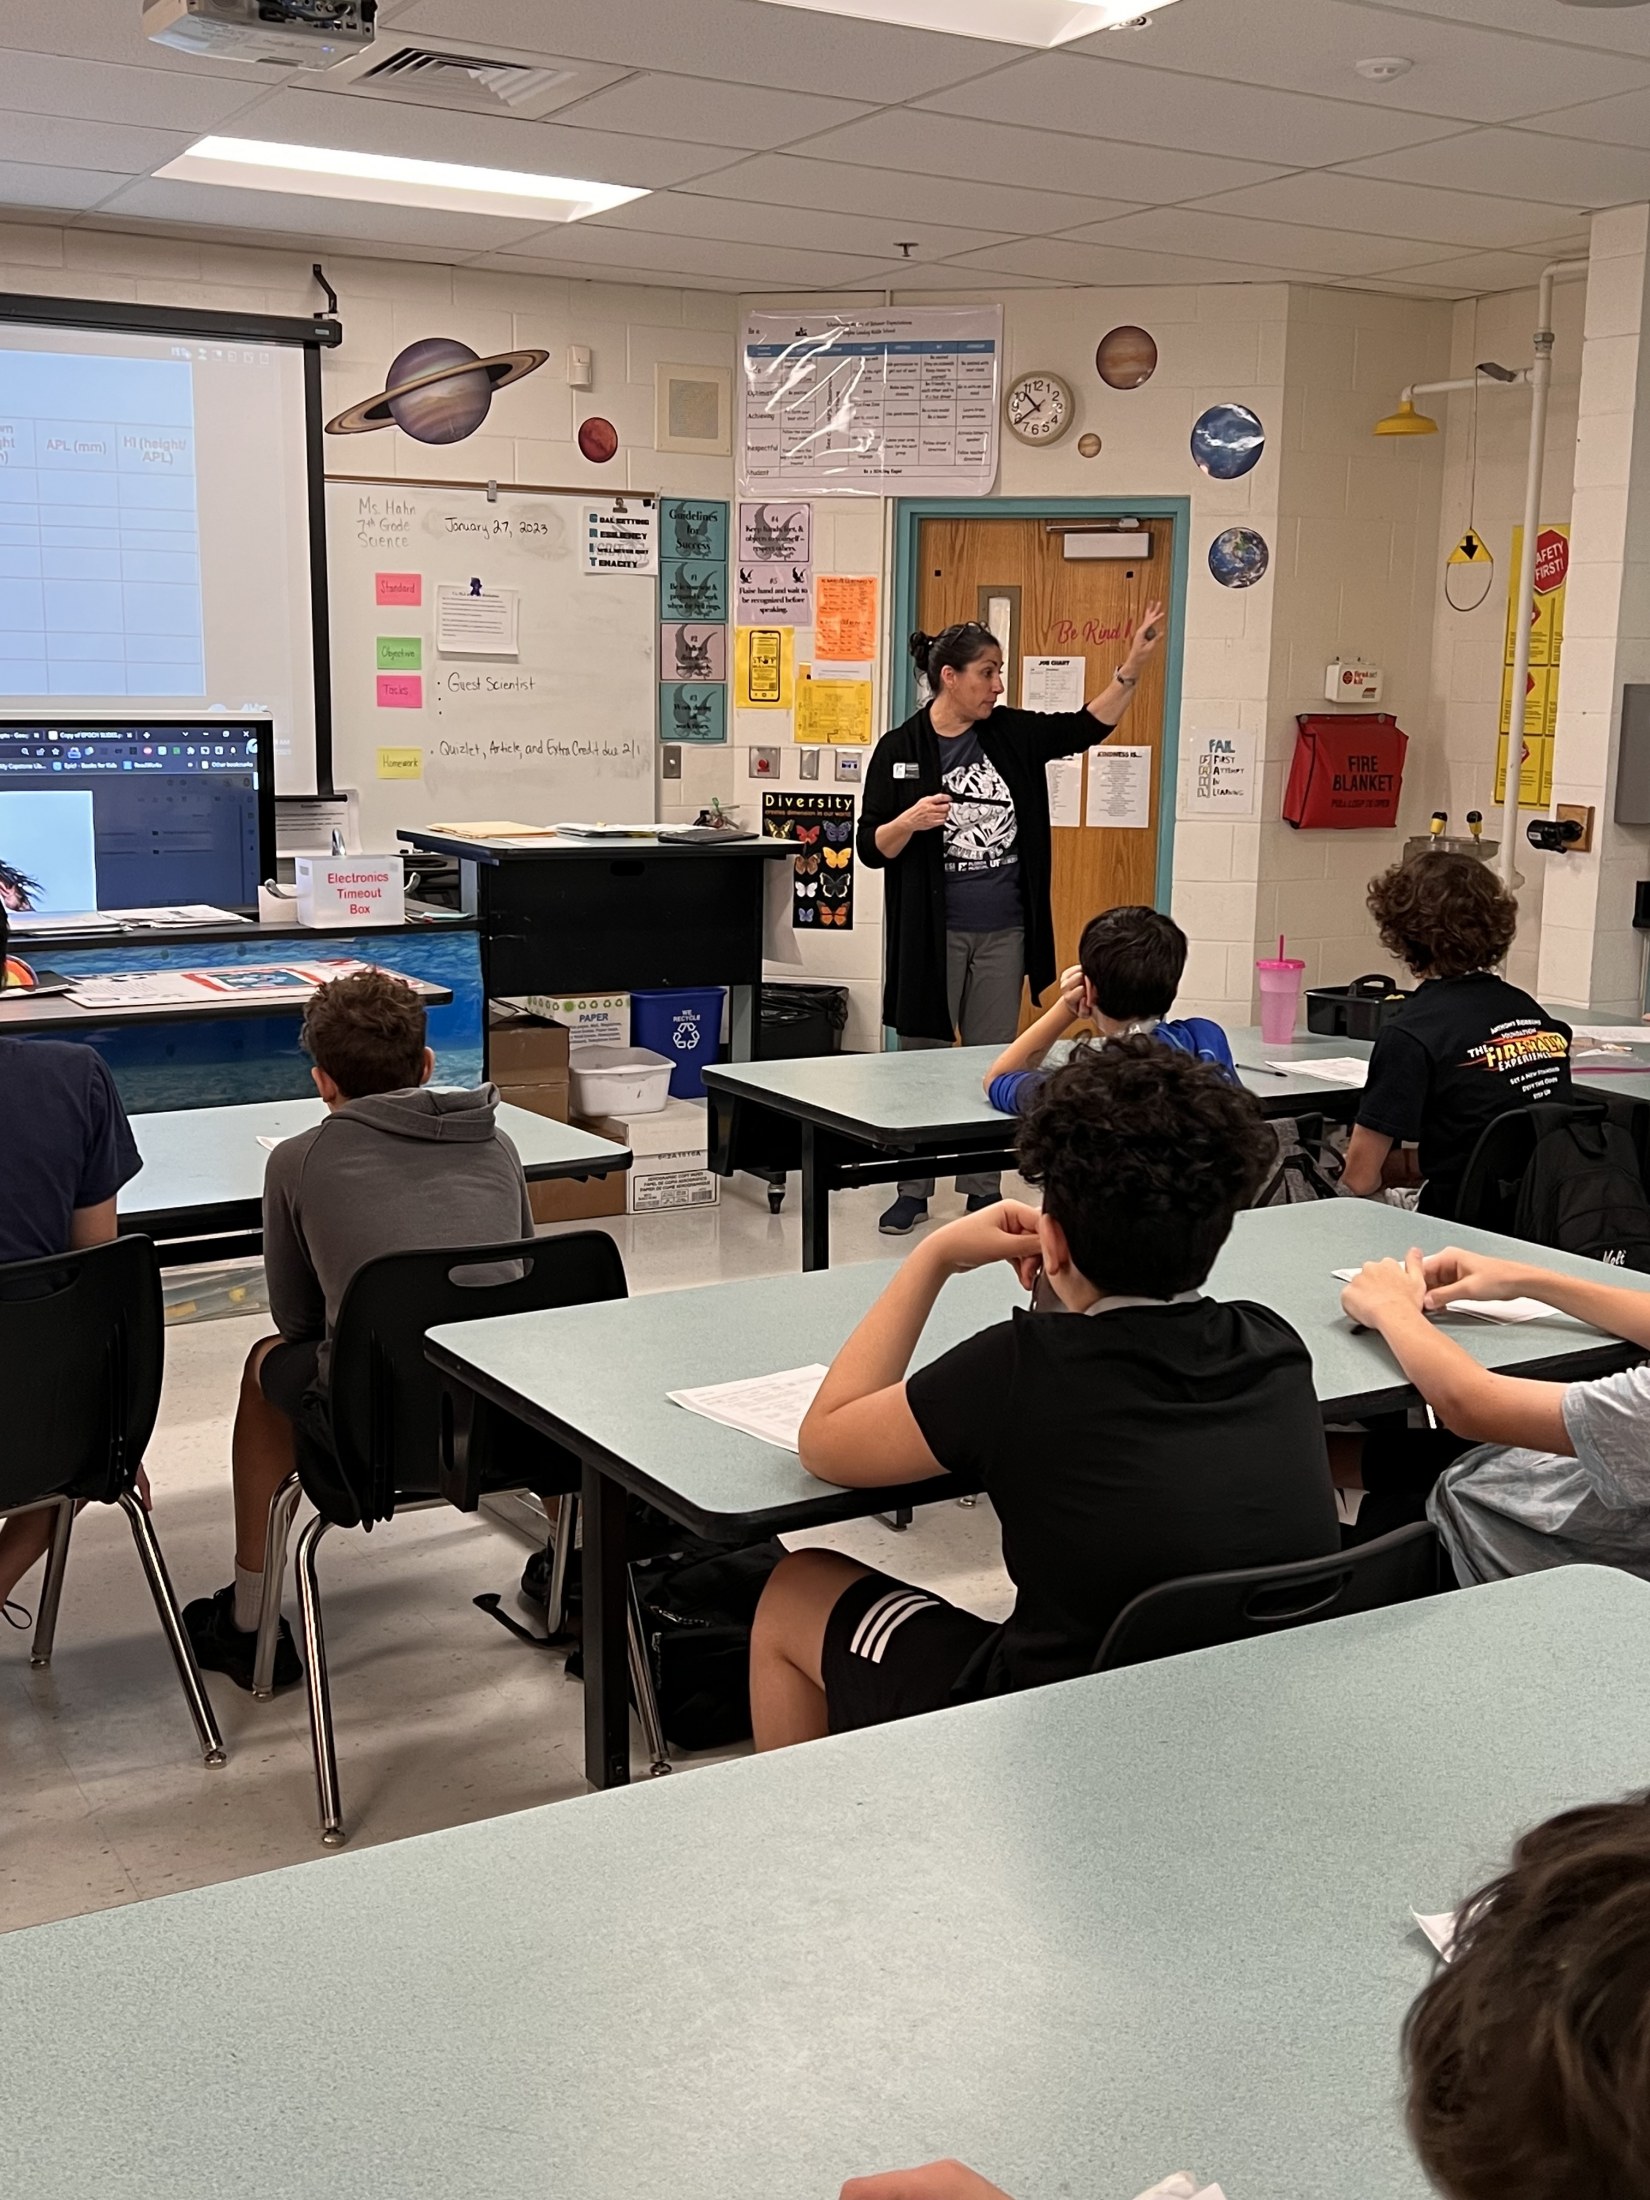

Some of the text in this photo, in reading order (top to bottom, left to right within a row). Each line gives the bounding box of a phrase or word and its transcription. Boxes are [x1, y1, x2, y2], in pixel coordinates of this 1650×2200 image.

[1024, 383, 1031, 394] 11
[1033, 380, 1044, 391] 12
[1046, 383, 1050, 393] 1
[1014, 391, 1026, 402] 10
[1052, 391, 1060, 401] 2
[1011, 401, 1020, 412] 9
[1056, 403, 1063, 414] 3
[1051, 414, 1058, 424] 4
[1023, 422, 1030, 432] 7
[1032, 424, 1040, 435] 6
[1042, 422, 1050, 432] 5
[47, 439, 107, 455] APL (mm)
[142, 451, 174, 465] APL)
[385, 499, 416, 515] Hahn
[668, 509, 718, 522] Guidelines
[445, 517, 549, 540] January 27, 2023
[686, 524, 700, 535] for
[357, 532, 409, 549] Science
[676, 540, 712, 551] Success
[1535, 557, 1564, 581] FIRST!
[380, 580, 416, 594] Standard
[758, 586, 774, 594] hand
[775, 586, 786, 594] and
[1051, 620, 1079, 644] Be
[381, 647, 416, 660] Objective
[448, 672, 536, 692] Guest Scientist
[383, 684, 408, 696] Tasks
[525, 740, 544, 754] and
[546, 738, 571, 756] Extra
[572, 740, 600, 757] Credit
[602, 741, 618, 756] due
[622, 740, 641, 759] 2/1
[1208, 739, 1236, 754] FAIL
[382, 754, 418, 768] Homework
[1214, 755, 1235, 764] FIRST
[1348, 756, 1378, 773] FIRE
[1332, 774, 1394, 792] BLANKET
[766, 794, 852, 811] Diversity
[327, 872, 389, 884] Electronics
[336, 888, 382, 899] Timeout
[350, 904, 371, 914] Box
[580, 1013, 608, 1022] PAPER
[672, 1014, 700, 1022] RECYCLE
[1467, 1044, 1488, 1058] THE
[1498, 1052, 1552, 1072] EXPERIENCE
